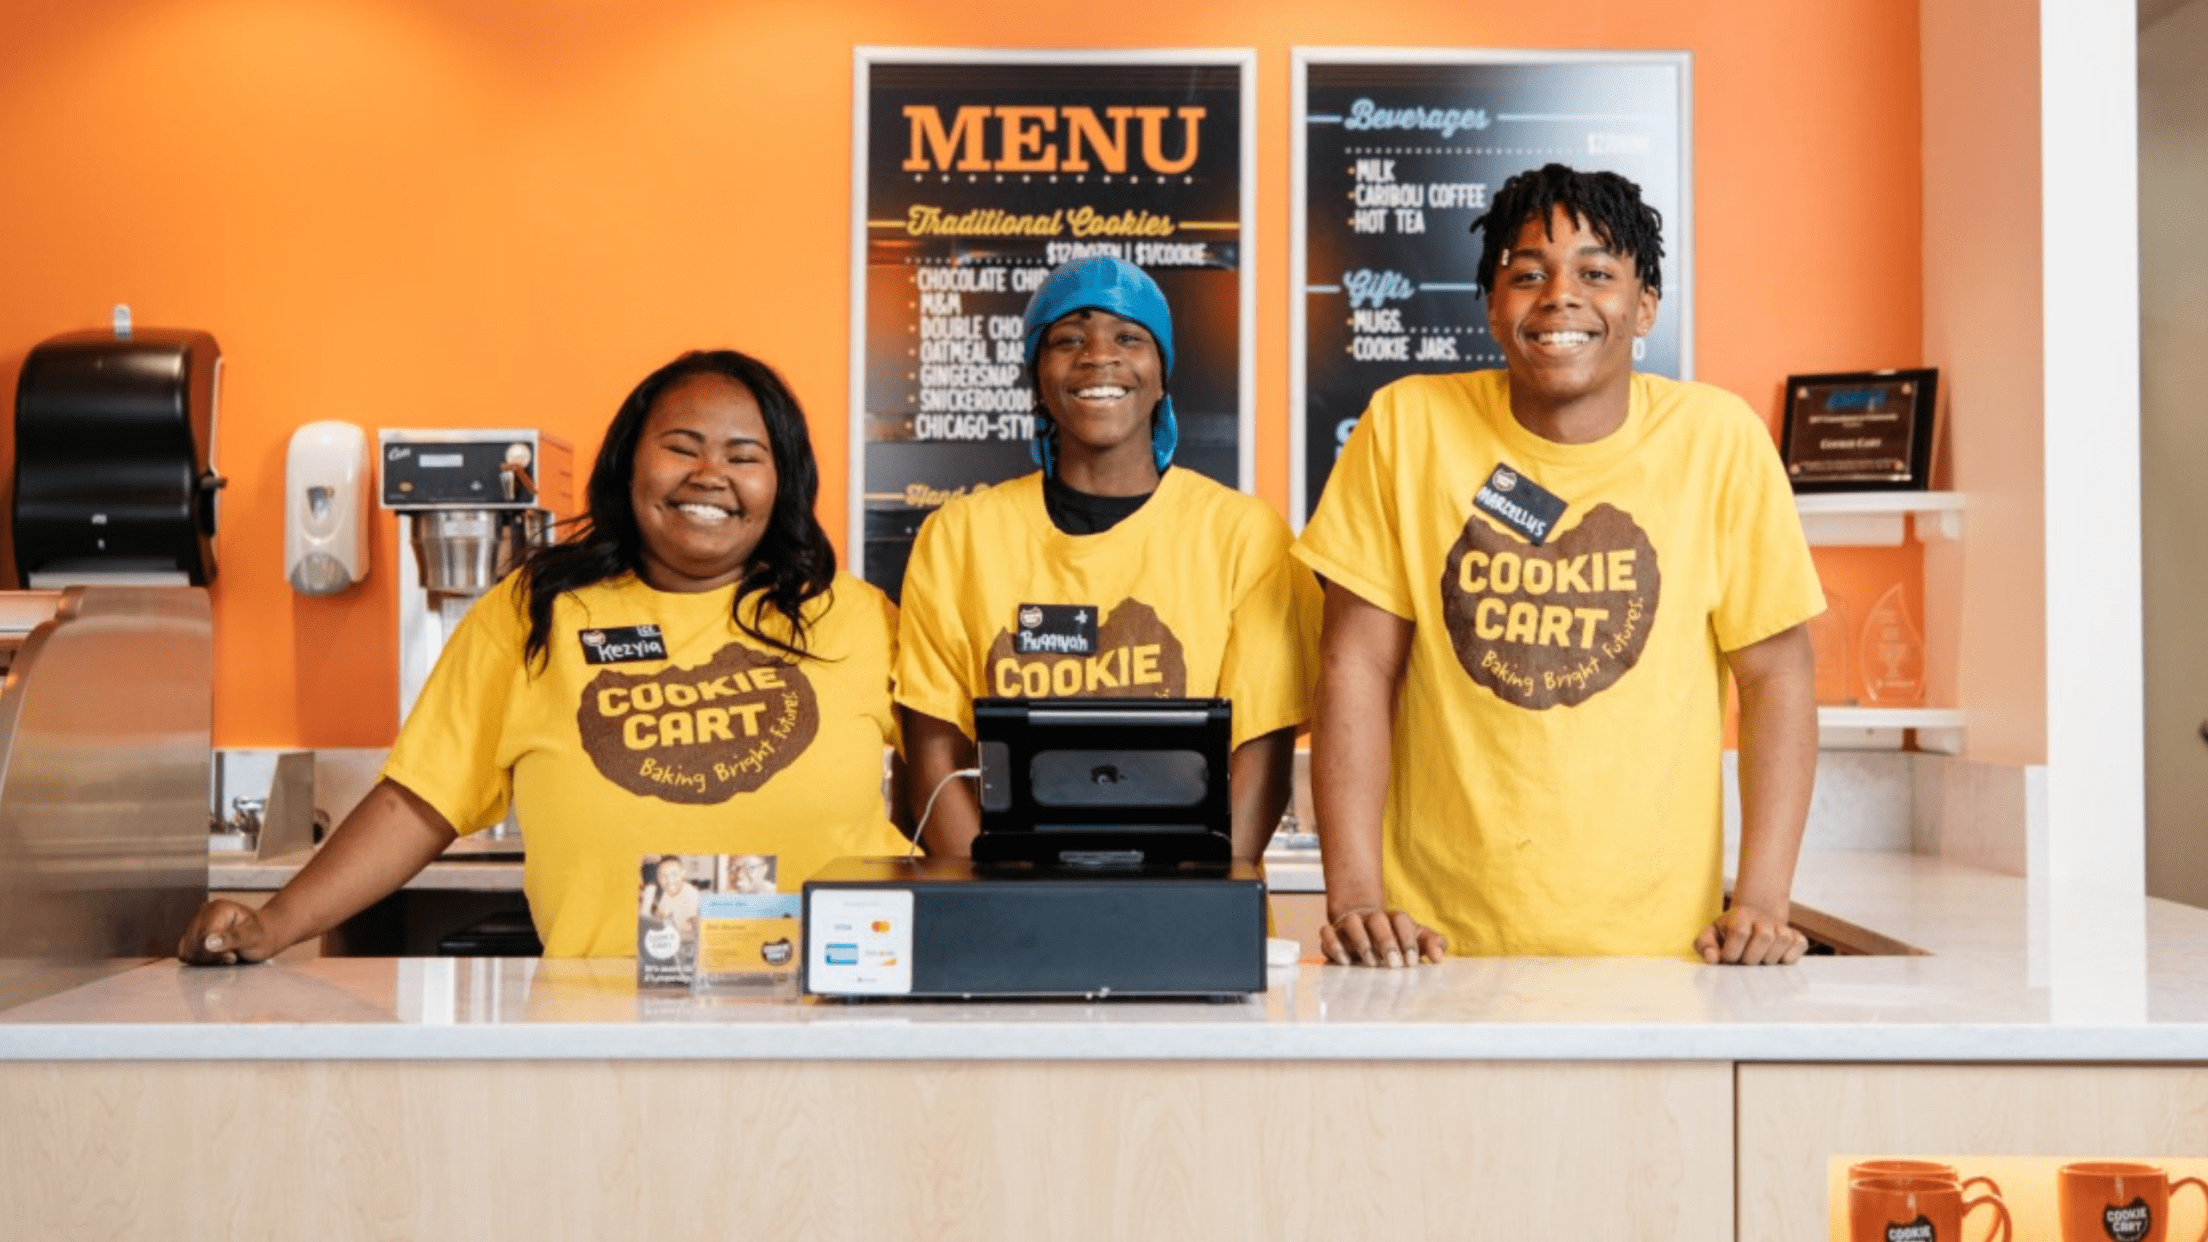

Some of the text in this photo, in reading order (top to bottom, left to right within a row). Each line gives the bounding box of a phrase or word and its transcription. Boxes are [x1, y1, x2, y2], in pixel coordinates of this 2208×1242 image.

[1344, 98, 1490, 138] Beverages
[902, 105, 1206, 173] MENU
[1356, 159, 1396, 182] MILK
[1355, 182, 1487, 208] CARIBOU COFFEE
[907, 205, 1175, 237] Traditional Cookies
[1354, 209, 1425, 234] HOT TEA
[918, 267, 1007, 291] CHOCOLATE
[1343, 269, 1415, 308] Gifts
[921, 315, 984, 340] DOUBLE
[921, 340, 991, 363] OATMEAL
[1353, 336, 1410, 361] COOKIE
[921, 364, 1020, 387] GINGERSNAP
[1459, 549, 1638, 595] COOKIE
[1475, 597, 1610, 650] CART
[995, 643, 1163, 698] COOKIE
[1481, 650, 1534, 697] Baking
[1543, 656, 1601, 691] Bright
[597, 666, 787, 717] COOKIE
[622, 702, 767, 750] CART
[639, 757, 706, 793] Baking
[712, 738, 776, 782] Bright
[2107, 1206, 2147, 1221] COOKIE
